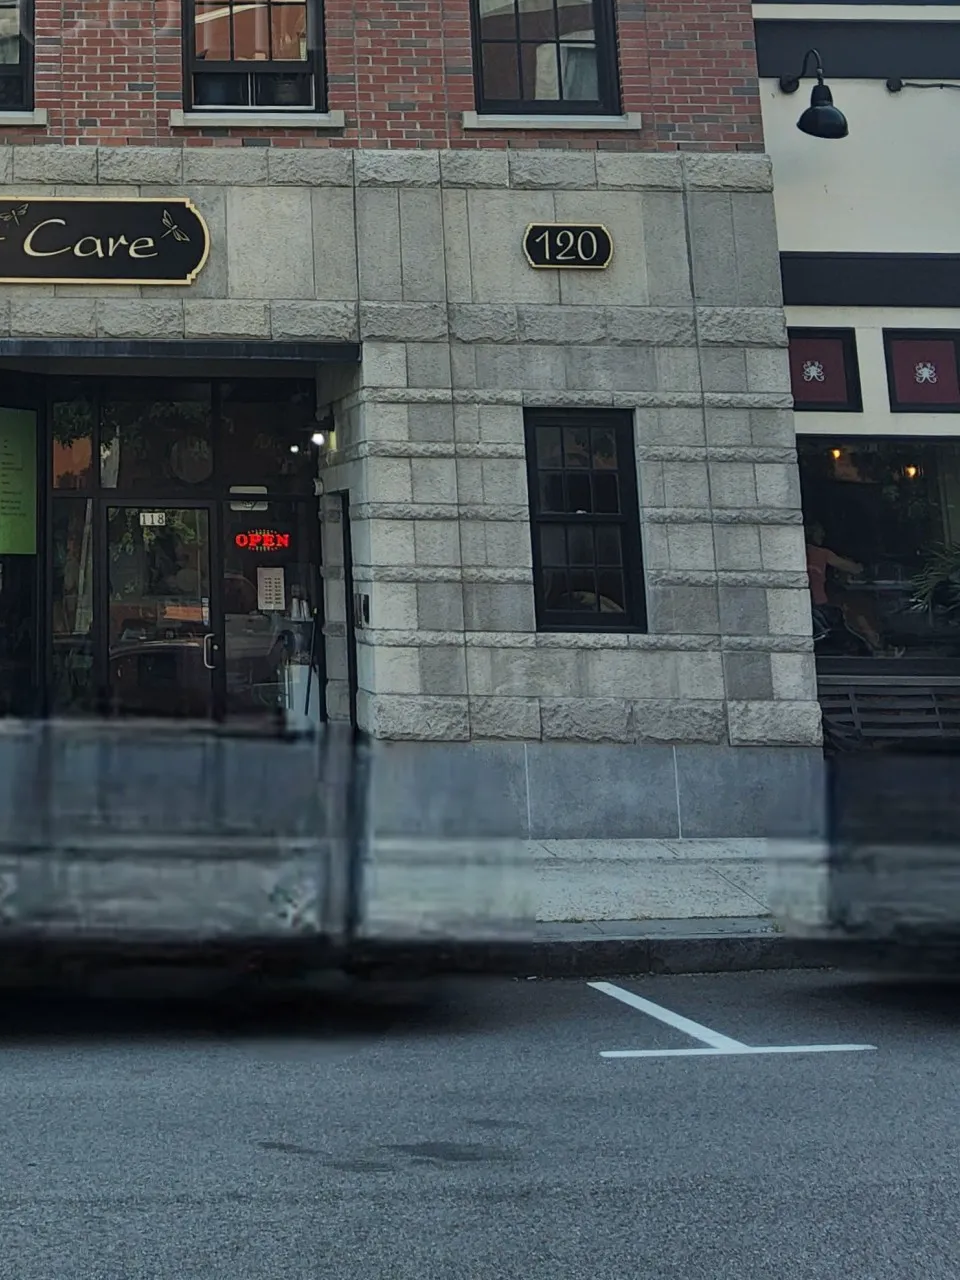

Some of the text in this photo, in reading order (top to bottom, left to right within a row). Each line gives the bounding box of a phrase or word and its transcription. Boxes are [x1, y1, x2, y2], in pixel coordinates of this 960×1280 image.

[21, 218, 159, 259] Care
[535, 230, 597, 261] 120
[142, 513, 165, 525] 118
[235, 533, 290, 547] OPEN
